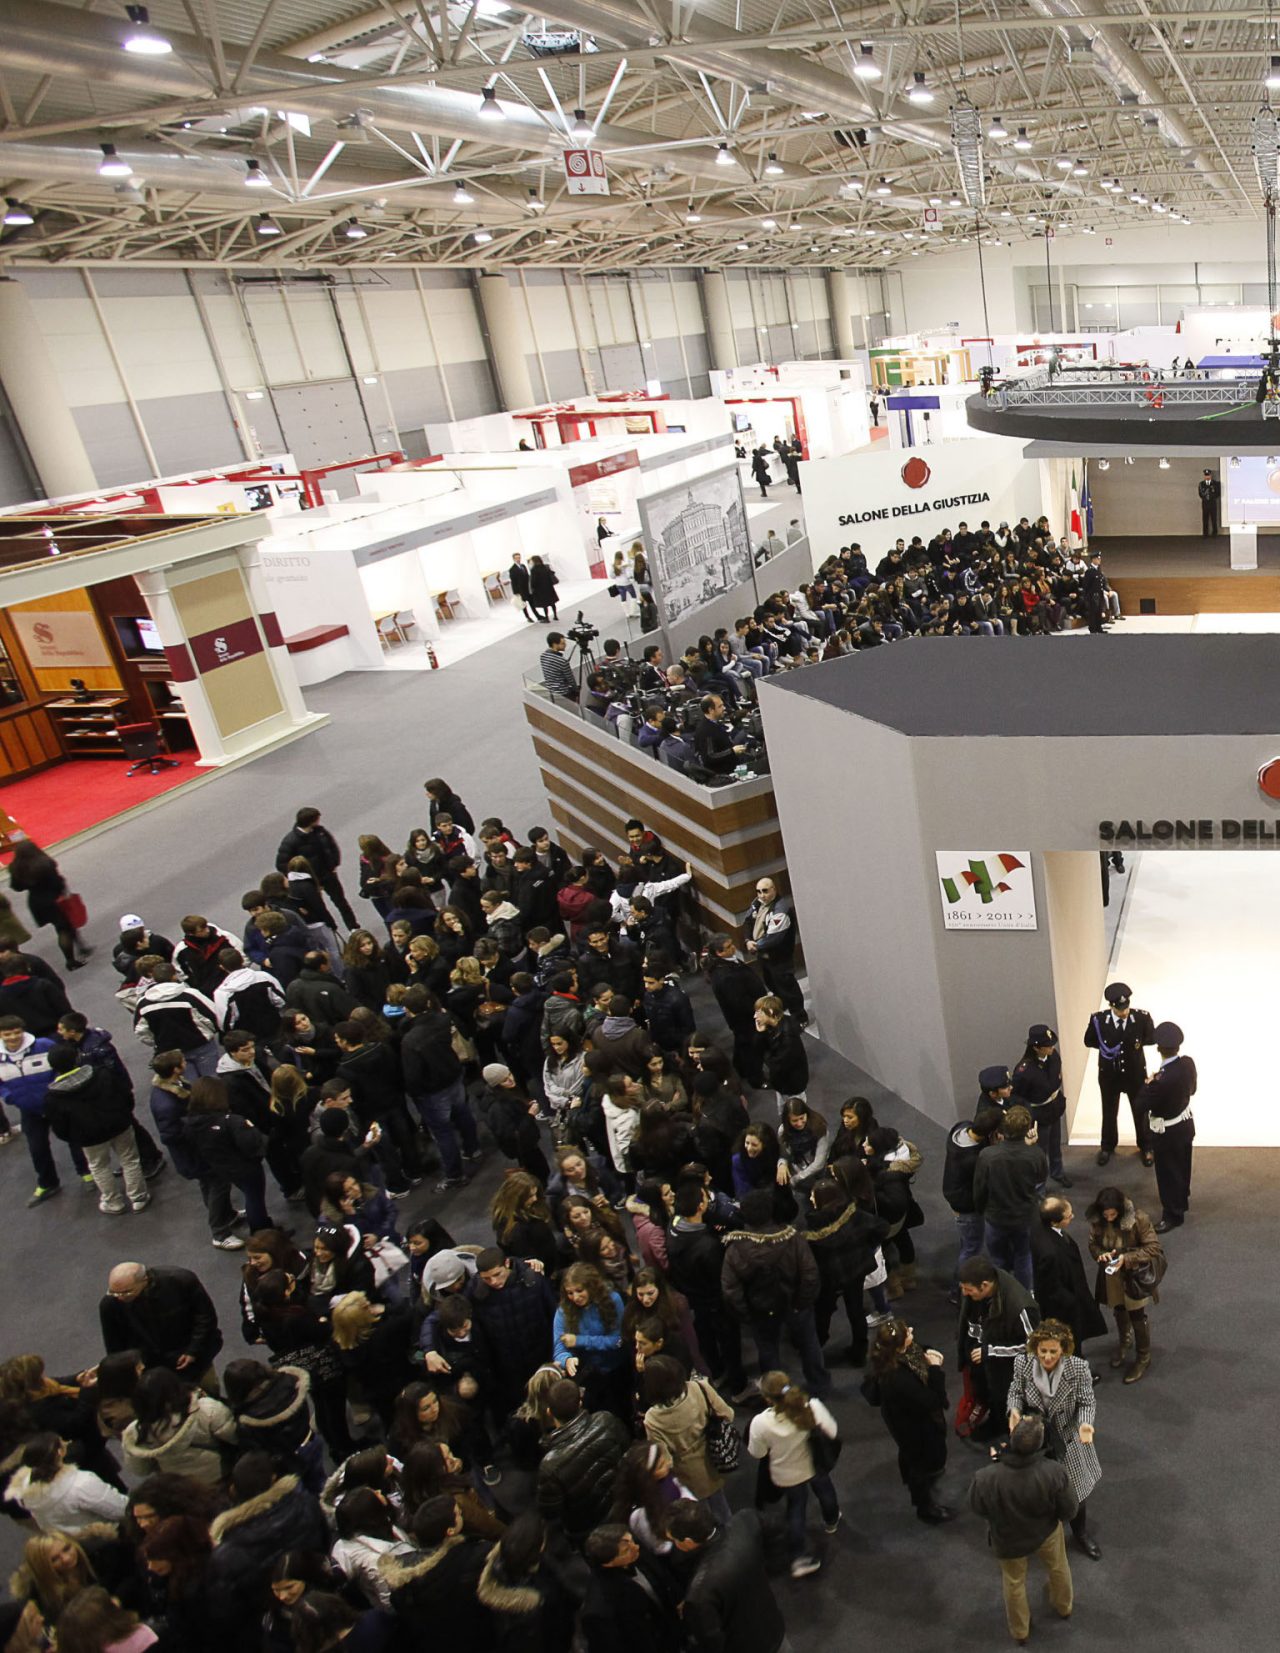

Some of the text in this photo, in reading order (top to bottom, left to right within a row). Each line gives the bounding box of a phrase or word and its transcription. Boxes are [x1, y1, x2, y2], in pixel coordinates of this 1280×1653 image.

[838, 492, 991, 526] SALONE DELLA GIUSTIZIA
[1098, 818, 1214, 842] SALONE
[947, 910, 1013, 920] 1861 2011
